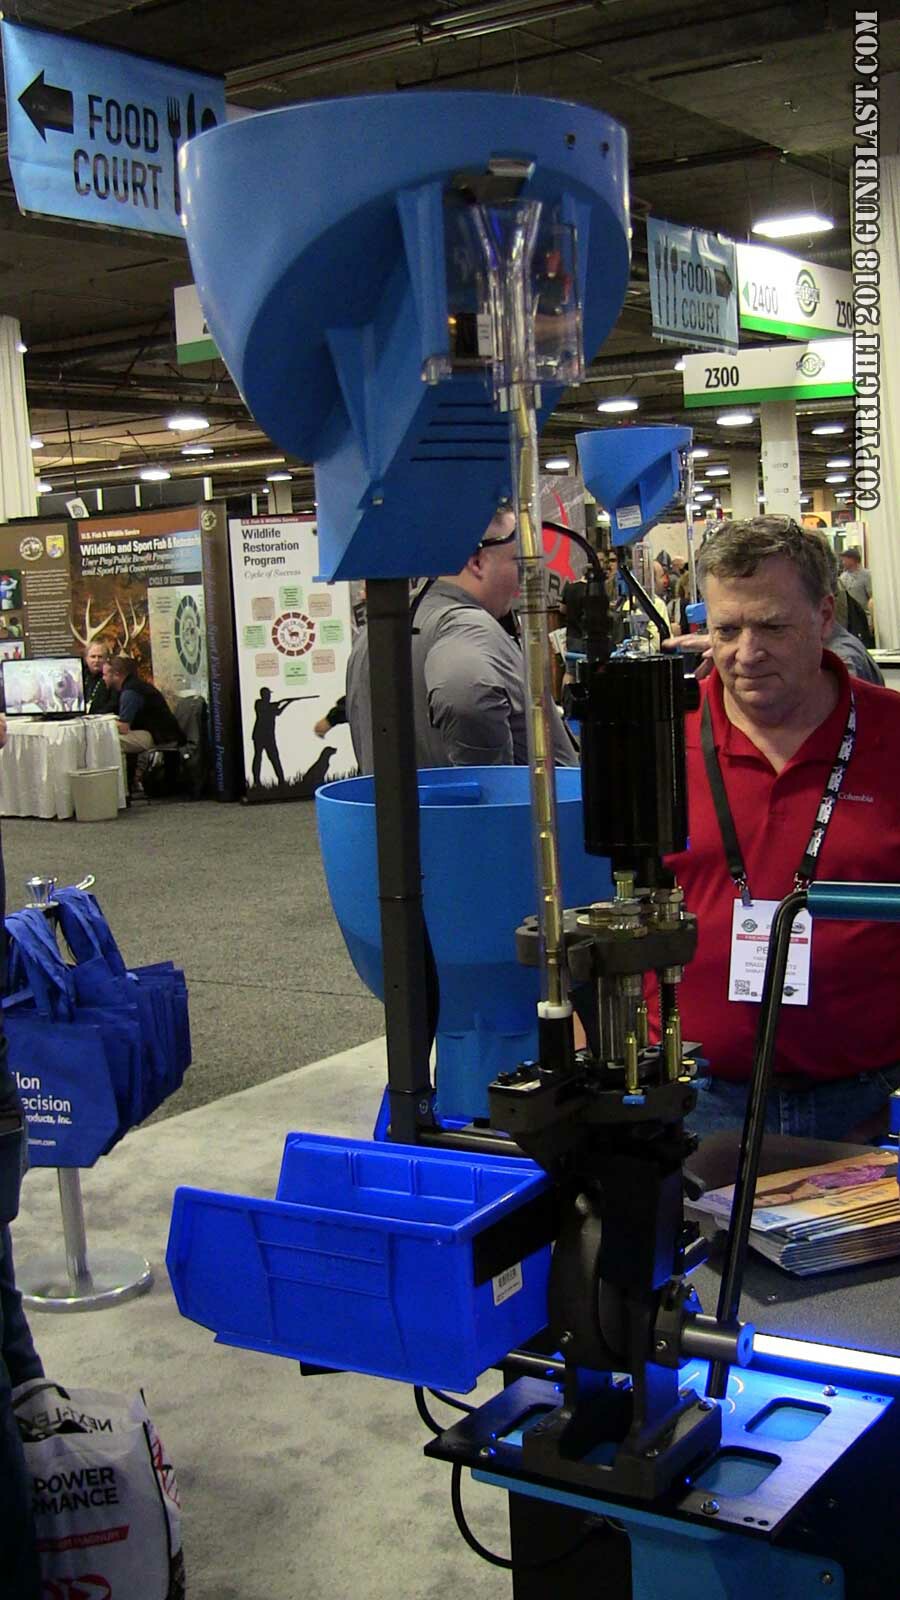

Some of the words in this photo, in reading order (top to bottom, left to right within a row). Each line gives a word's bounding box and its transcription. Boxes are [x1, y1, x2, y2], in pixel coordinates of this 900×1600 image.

[87, 94, 159, 154] FOOD
[73, 149, 163, 210] COURT
[681, 259, 712, 295] FOOD
[752, 282, 779, 315] 2400
[682, 298, 721, 335] COURT
[705, 366, 739, 388] 2300
[241, 528, 281, 540] Wildlife
[80, 542, 116, 556] Wildlife
[117, 541, 132, 553] and
[132, 540, 153, 555] Sport
[153, 538, 167, 550] Fish
[243, 540, 300, 552] Restoration
[243, 555, 286, 568] Program
[244, 570, 264, 580] Cycle
[838, 791, 874, 803] Columbia
[12, 1072, 40, 1090] lon
[34, 1467, 115, 1496] POWER
